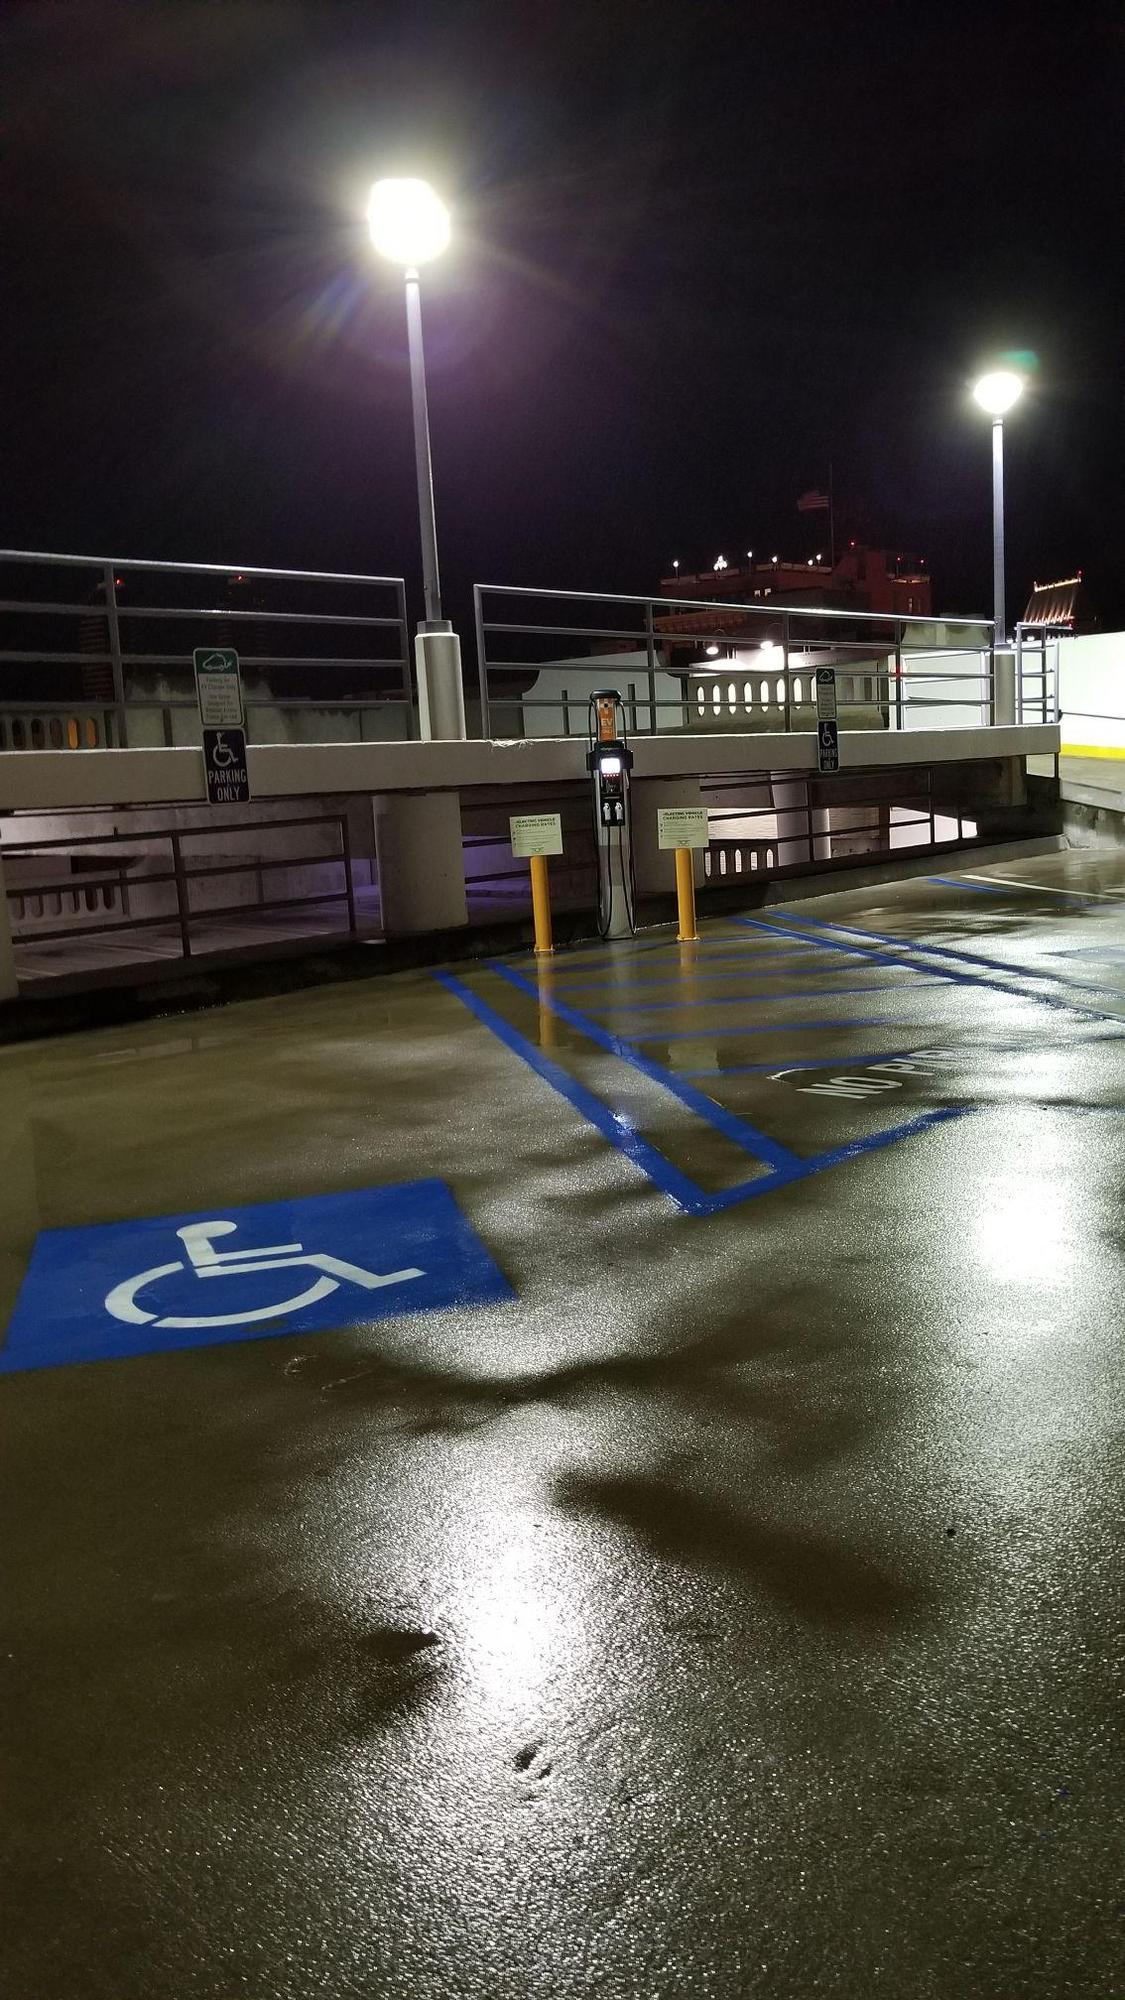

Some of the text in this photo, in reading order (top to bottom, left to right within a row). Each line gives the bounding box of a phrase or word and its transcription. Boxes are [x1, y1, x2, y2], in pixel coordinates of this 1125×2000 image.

[208, 768, 246, 784] PARKING
[217, 786, 240, 801] ONLY
[796, 1076, 903, 1099] NO
